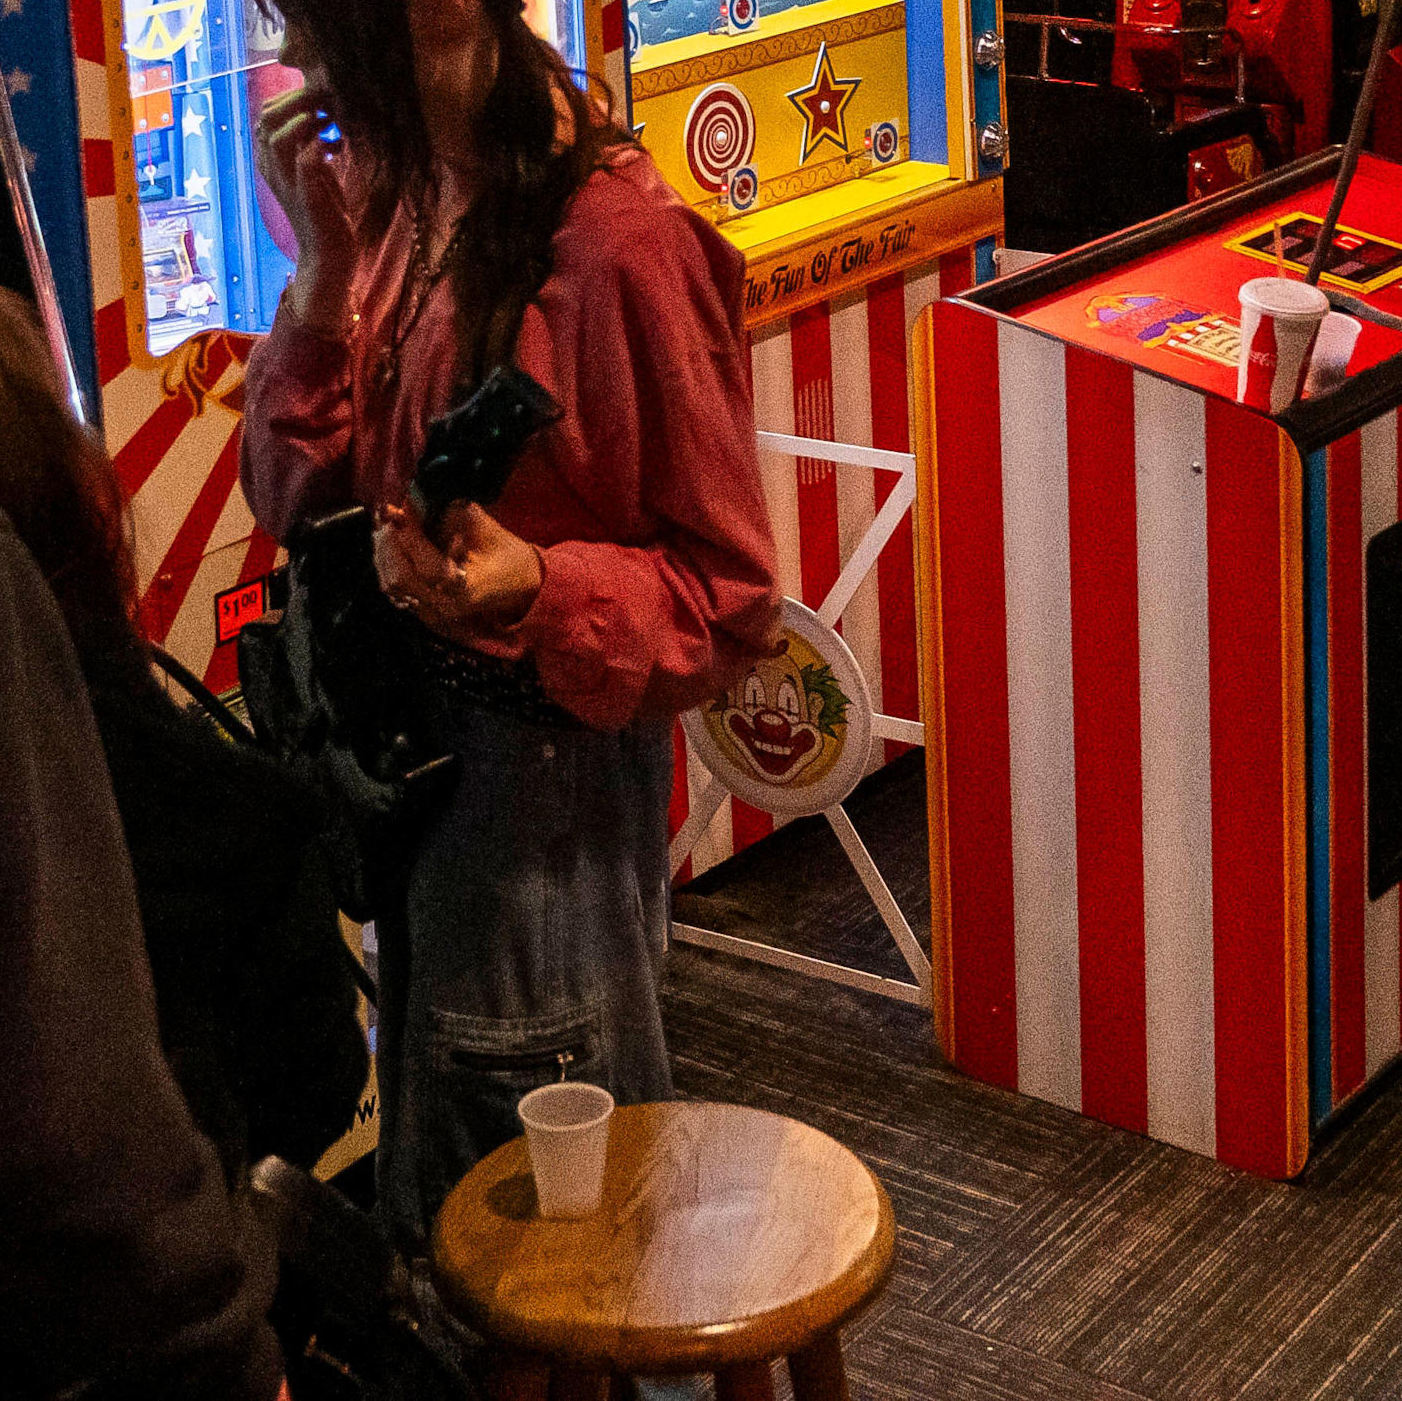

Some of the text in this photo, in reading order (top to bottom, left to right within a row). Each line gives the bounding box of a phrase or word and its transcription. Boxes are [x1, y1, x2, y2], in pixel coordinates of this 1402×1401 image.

[770, 263, 806, 301] Fun
[810, 246, 837, 286] Of
[841, 236, 875, 274] The
[878, 220, 916, 262] Fair
